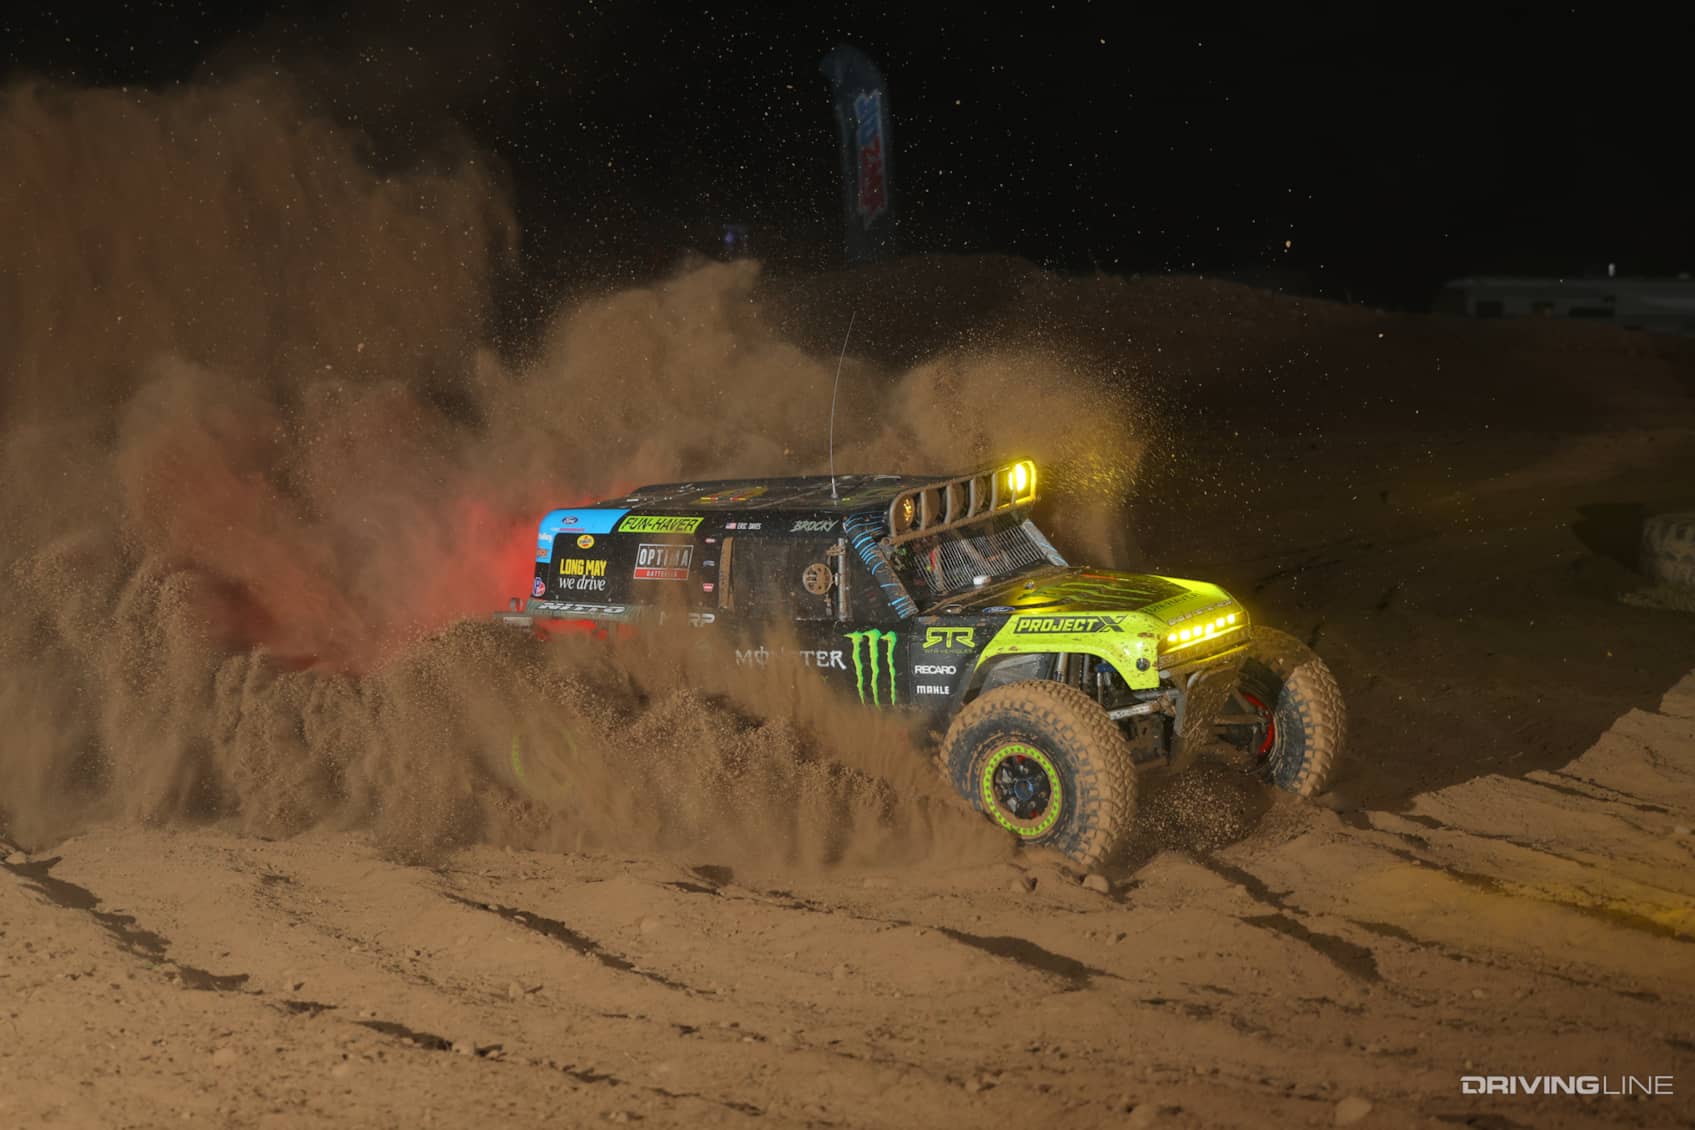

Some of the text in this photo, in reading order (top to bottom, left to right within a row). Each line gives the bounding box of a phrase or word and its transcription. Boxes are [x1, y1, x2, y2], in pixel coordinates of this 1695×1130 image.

[622, 516, 696, 532] FUN-HAVER
[560, 558, 607, 577] LONG MAY
[560, 577, 575, 590] we
[576, 575, 606, 592] drive
[736, 645, 847, 670] MOTER
[914, 664, 957, 675] RECARO
[916, 684, 950, 695] MAHLE
